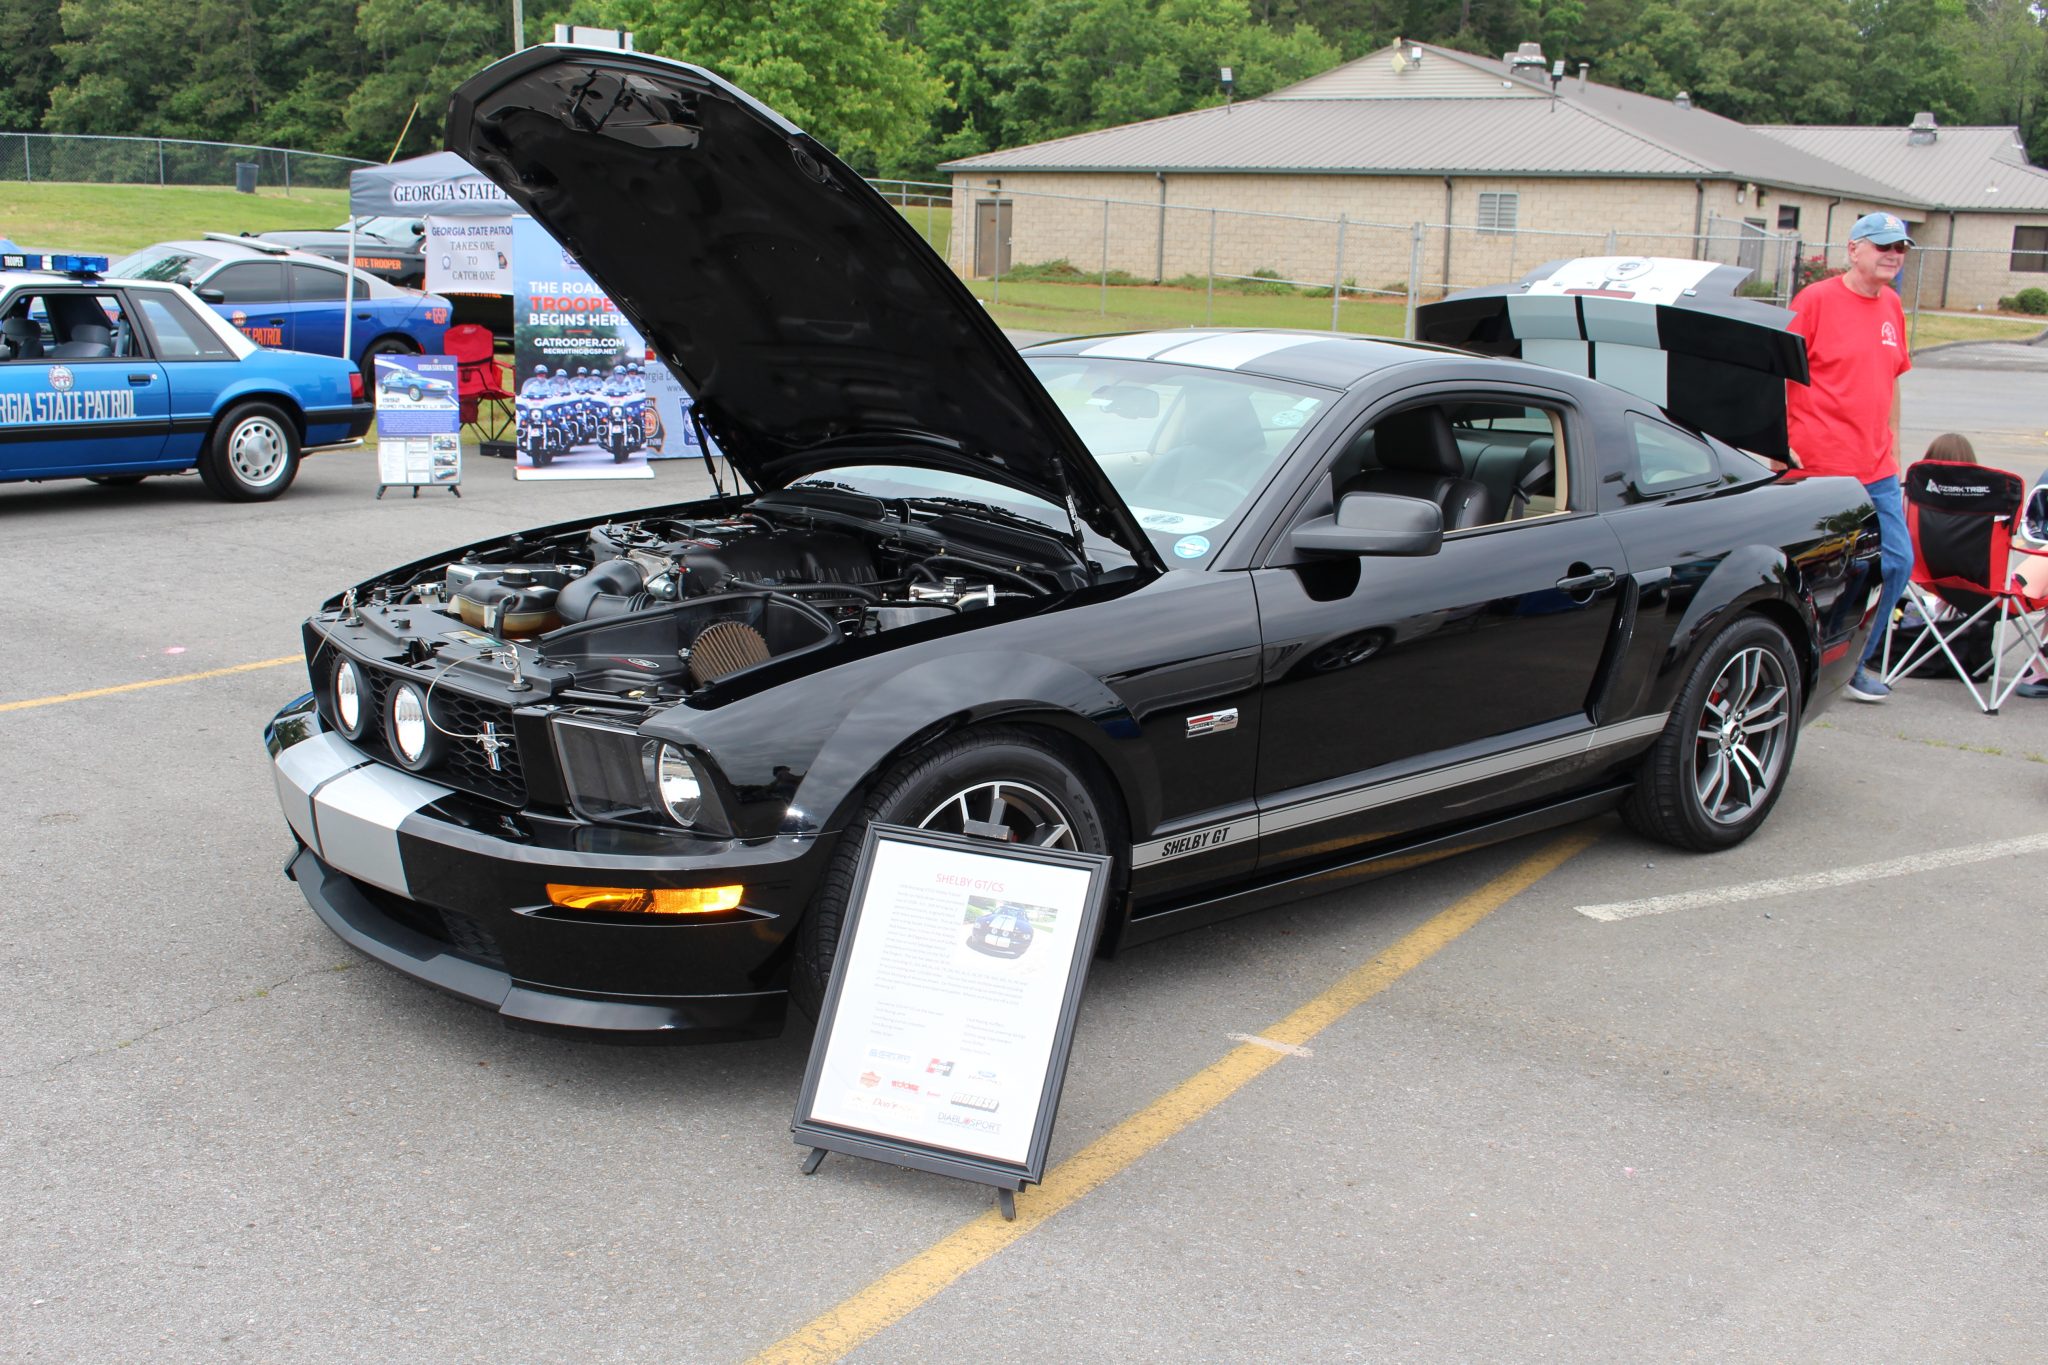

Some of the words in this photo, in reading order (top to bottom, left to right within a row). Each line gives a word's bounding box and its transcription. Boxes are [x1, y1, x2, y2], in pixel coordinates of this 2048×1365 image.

[394, 184, 456, 202] GEORGIA
[459, 183, 499, 200] STATE
[432, 227, 465, 236] GEORGIA
[467, 226, 488, 236] STATE
[451, 241, 478, 250] TAKES
[480, 241, 495, 250] ONE
[4, 256, 24, 267] TROOPER
[354, 257, 369, 268] TATE
[370, 258, 402, 270] TROOPER
[466, 256, 478, 265] TO
[452, 271, 477, 280] CATCH
[479, 271, 495, 280] ONE
[529, 282, 558, 294] THE
[530, 296, 620, 312] TROOPE
[432, 308, 447, 324] GSP
[529, 313, 586, 326] BEGINS
[589, 313, 629, 326] HERE
[252, 327, 282, 346] PATROL
[534, 338, 625, 347] GATROOPER.COM
[36, 391, 83, 422] STATE
[85, 389, 137, 420] PATROL
[1162, 831, 1211, 857] SHELBY
[1212, 827, 1231, 844] GT
[935, 873, 972, 887] SHELBY
[974, 878, 1005, 893] GT/CS
